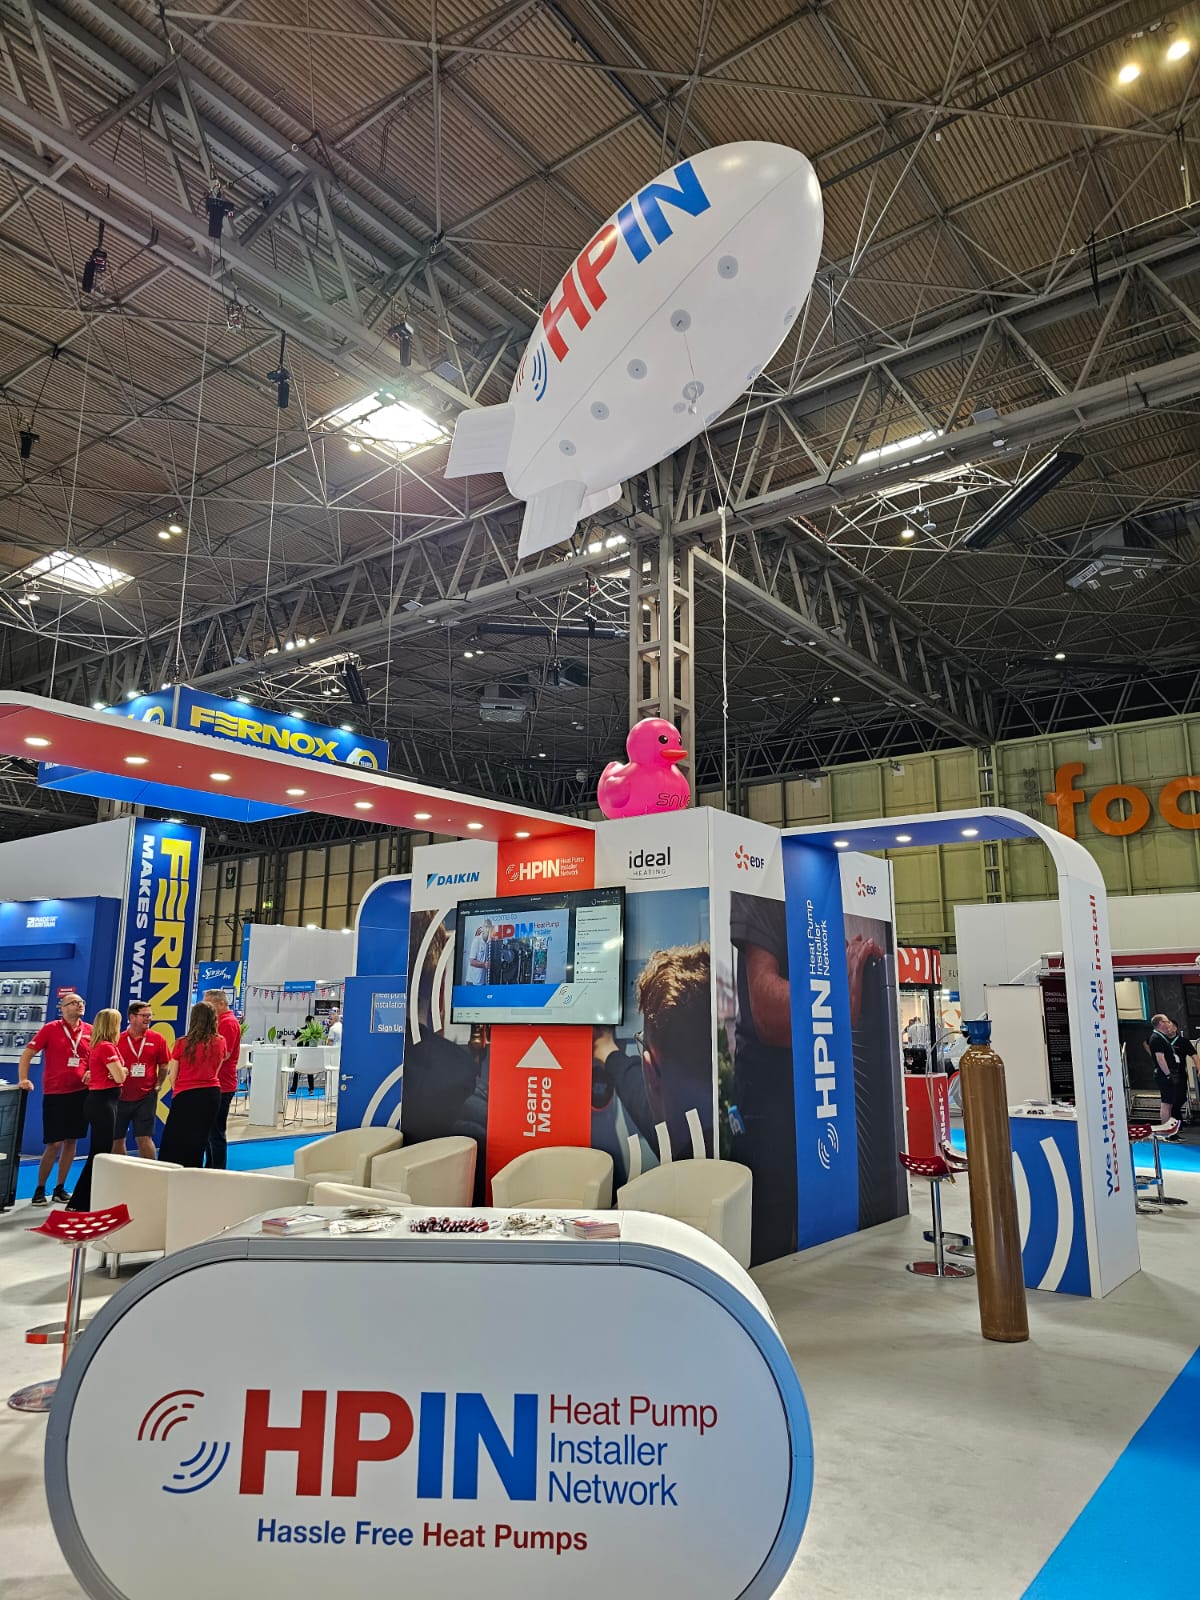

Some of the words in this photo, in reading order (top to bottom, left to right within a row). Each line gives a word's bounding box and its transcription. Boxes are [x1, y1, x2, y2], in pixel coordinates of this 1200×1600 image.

[542, 160, 711, 364] HPIN
[190, 704, 340, 762] FERNOX
[136, 834, 155, 929] MAKES
[437, 871, 480, 886] DAIKIN
[519, 858, 560, 881] HPIN
[628, 846, 671, 869] ideal
[632, 868, 667, 877] HEATING
[814, 922, 823, 975] Installer
[820, 919, 830, 976] Network
[1089, 894, 1102, 971] Install
[129, 938, 147, 1006] WAT
[375, 1000, 406, 1009] nstallation
[1090, 980, 1099, 1013] All
[1098, 978, 1106, 1019] the
[377, 1023, 393, 1032] Sign
[393, 1023, 403, 1033] Up
[809, 978, 838, 1119] HPIN
[1102, 1029, 1111, 1077] you
[523, 1075, 538, 1137] Learn
[537, 1076, 552, 1133] More
[1097, 1048, 1109, 1143] Handle
[1107, 1086, 1121, 1193] Leaving
[1105, 1153, 1114, 1198] We
[549, 1394, 621, 1425] Heat
[629, 1395, 718, 1436] Pump
[239, 1389, 538, 1501] HPIN
[550, 1432, 668, 1466] Installer
[549, 1470, 678, 1506] Network
[256, 1518, 346, 1544] Hassle
[354, 1521, 414, 1547] Free
[422, 1522, 486, 1548] Heat
[494, 1524, 588, 1556] Pumps
